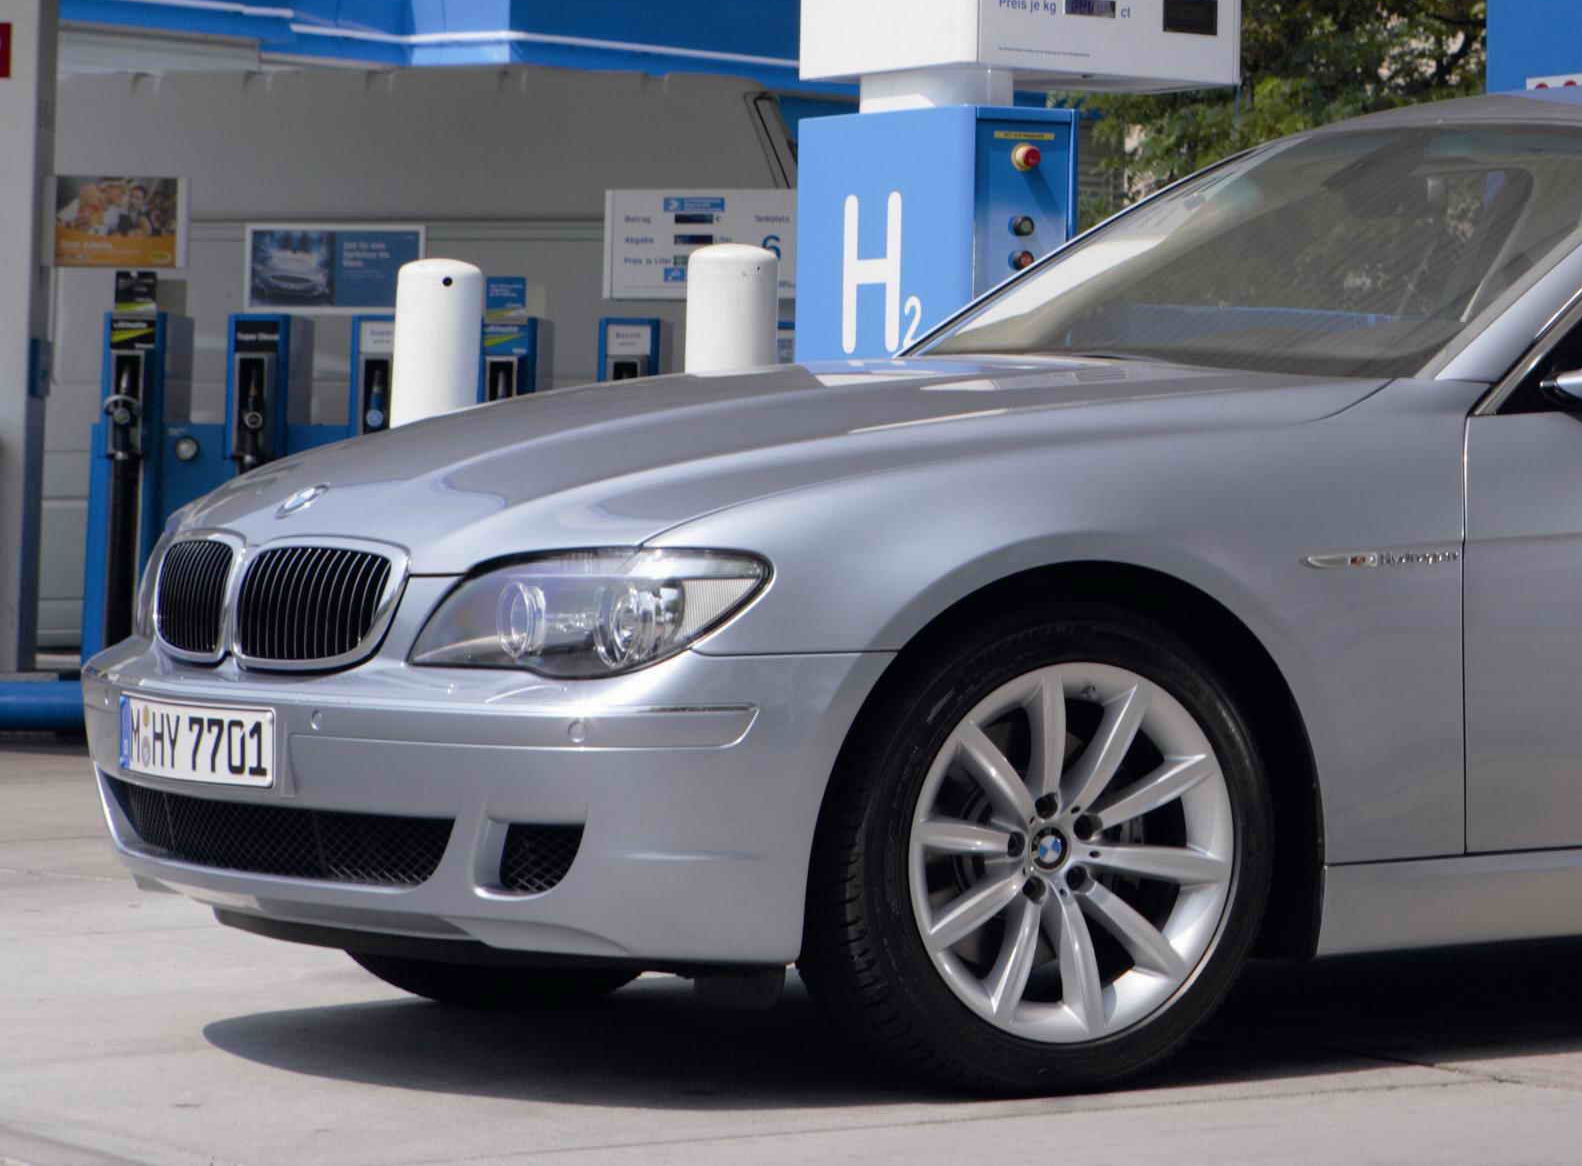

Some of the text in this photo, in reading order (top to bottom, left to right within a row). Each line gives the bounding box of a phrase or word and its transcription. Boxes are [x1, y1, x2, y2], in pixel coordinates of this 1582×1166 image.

[762, 234, 782, 260] 6
[131, 706, 267, 777] M HY 7701
